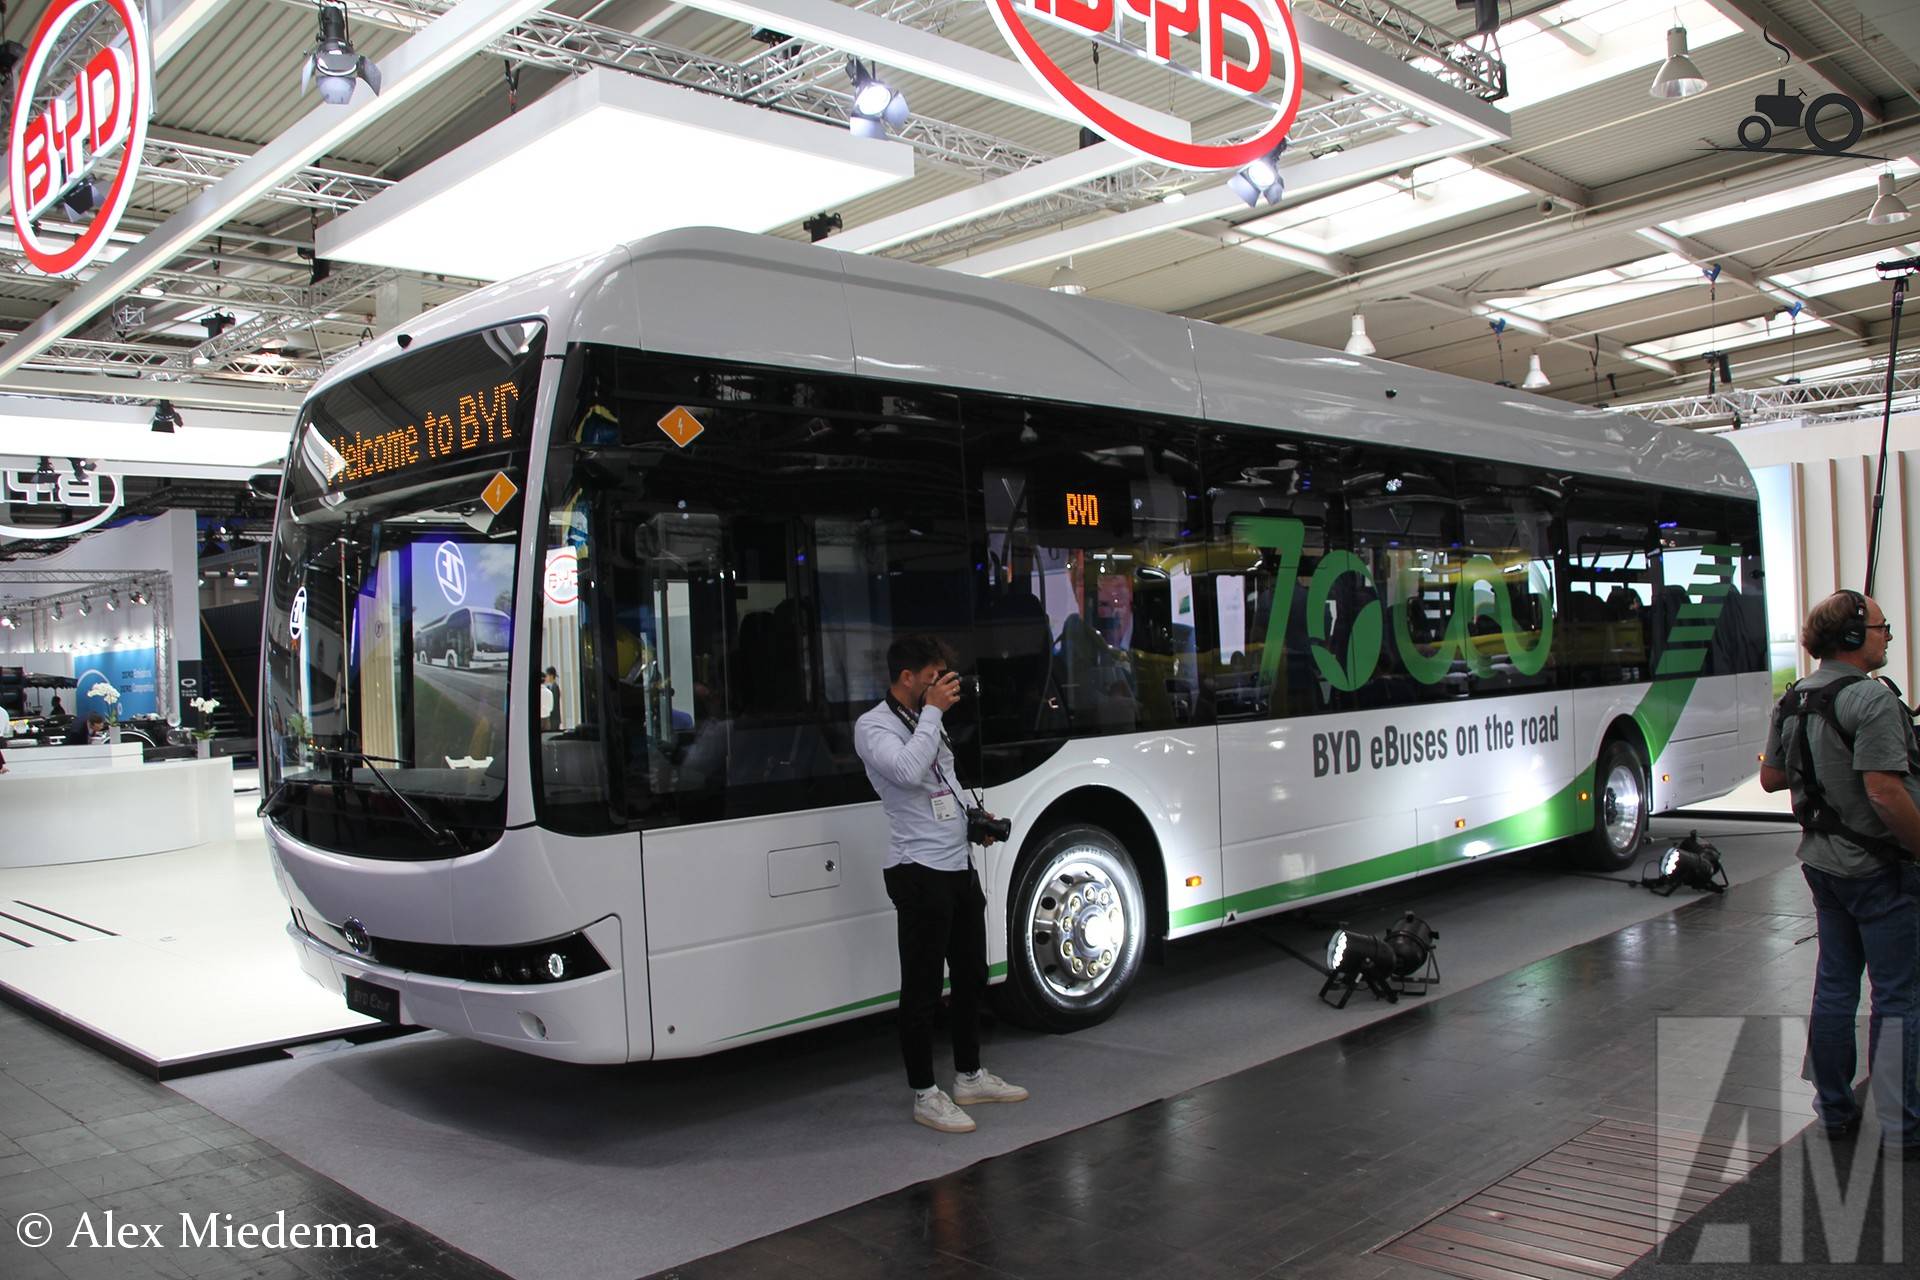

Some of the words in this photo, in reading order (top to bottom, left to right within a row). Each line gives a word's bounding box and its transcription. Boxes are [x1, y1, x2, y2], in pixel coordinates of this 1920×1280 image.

[23, 46, 131, 215] BYD
[424, 411, 453, 457] to
[1066, 493, 1099, 526] BYD
[1312, 729, 1361, 778] BYD
[1370, 715, 1448, 769] eBuses
[1456, 722, 1479, 756] on
[1485, 714, 1514, 750] the
[1521, 705, 1559, 745] road
